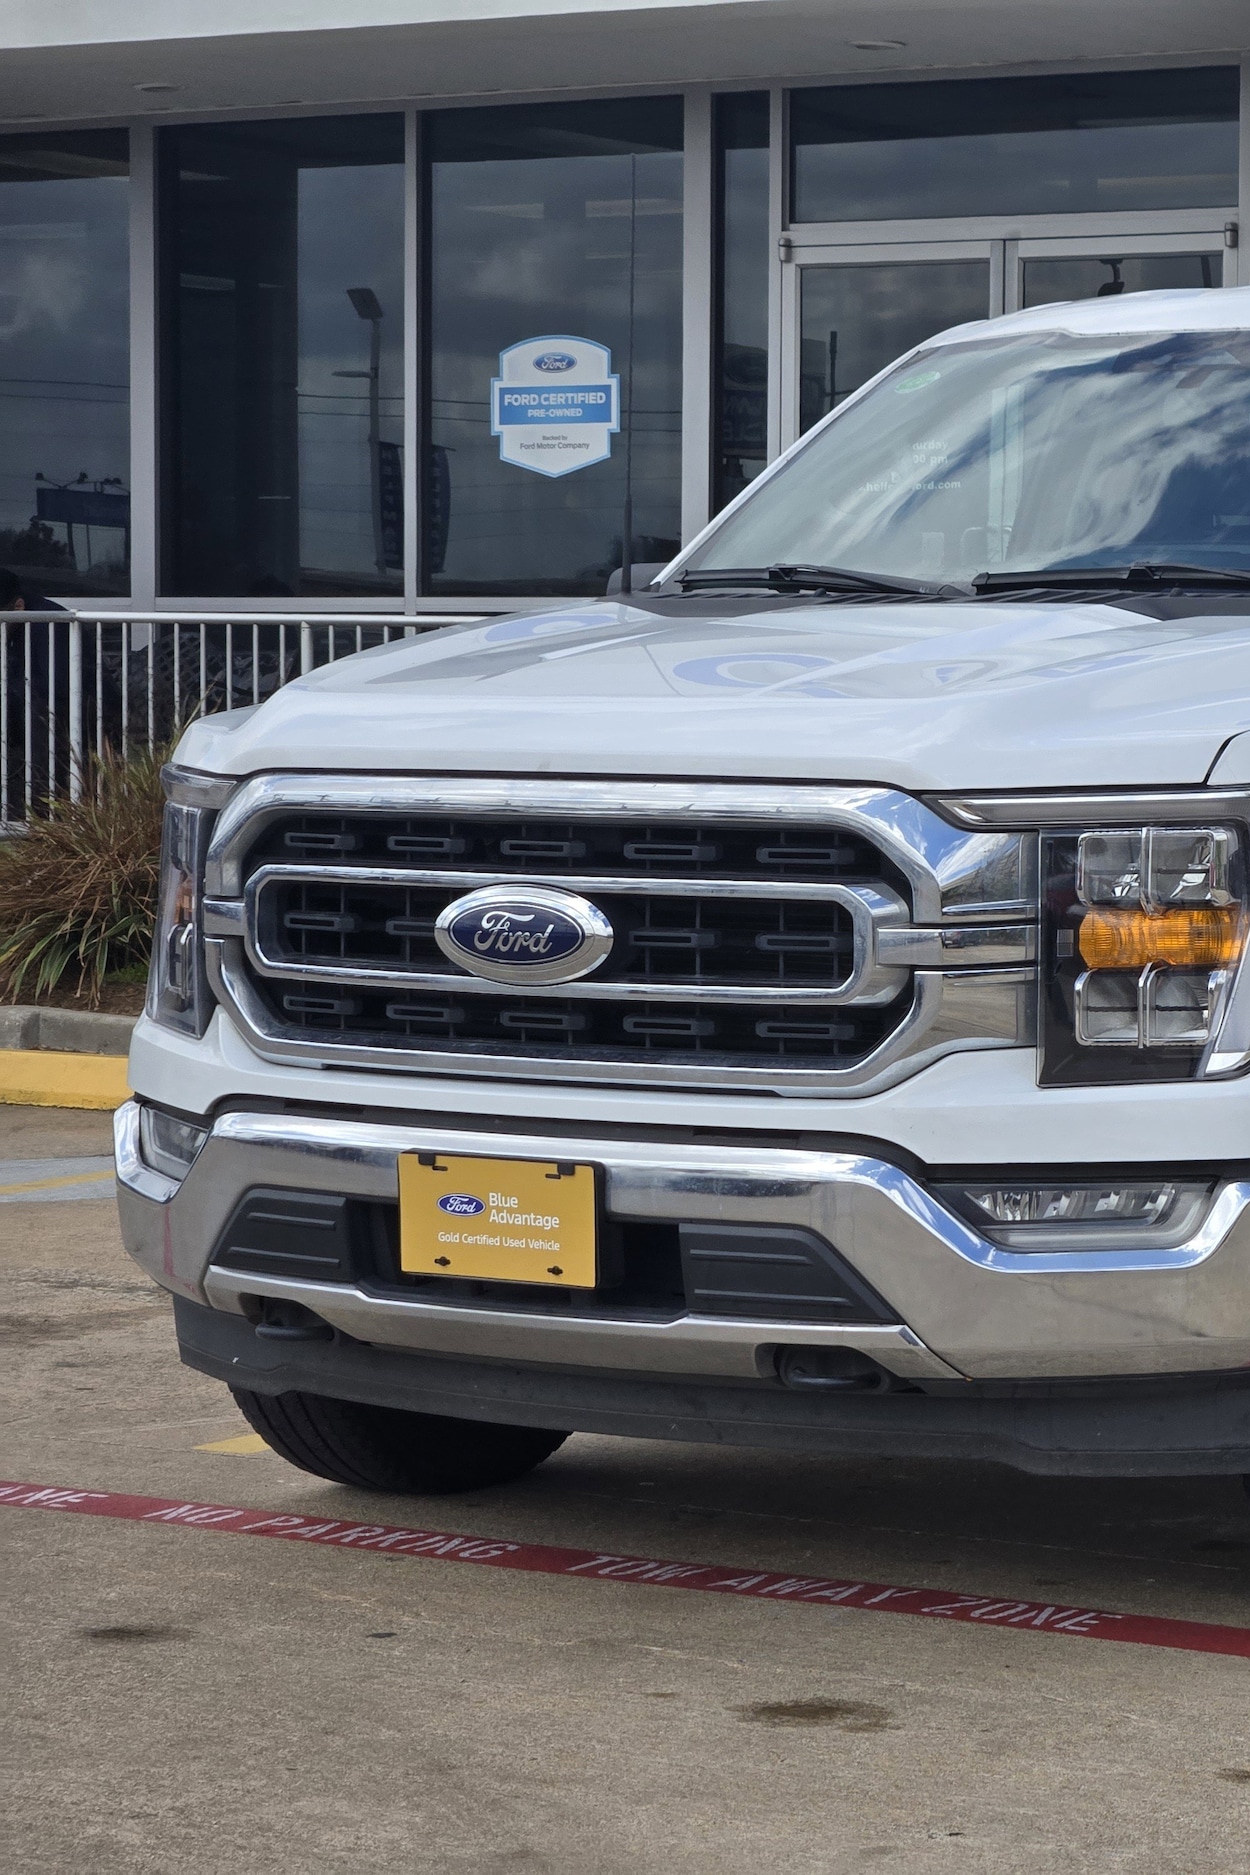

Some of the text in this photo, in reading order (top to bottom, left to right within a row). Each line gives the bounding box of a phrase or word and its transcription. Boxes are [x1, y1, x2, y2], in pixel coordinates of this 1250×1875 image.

[541, 355, 568, 370] Ford
[504, 392, 606, 406] FORD CERTIFIED
[528, 408, 583, 418] PRE-OWNED
[536, 442, 557, 450] Motor
[557, 442, 590, 451] Company
[473, 910, 555, 954] Ford
[446, 1196, 476, 1214] Ford
[488, 1192, 519, 1208] Blue
[489, 1208, 560, 1229] Advantage
[438, 1231, 561, 1251] Gold Certified Used Vehicle
[142, 1504, 244, 1524] NO
[238, 1515, 520, 1559] PARKING
[565, 1555, 711, 1581] TOW
[707, 1574, 921, 1605] AWAY
[920, 1596, 1125, 1632] ZONE
